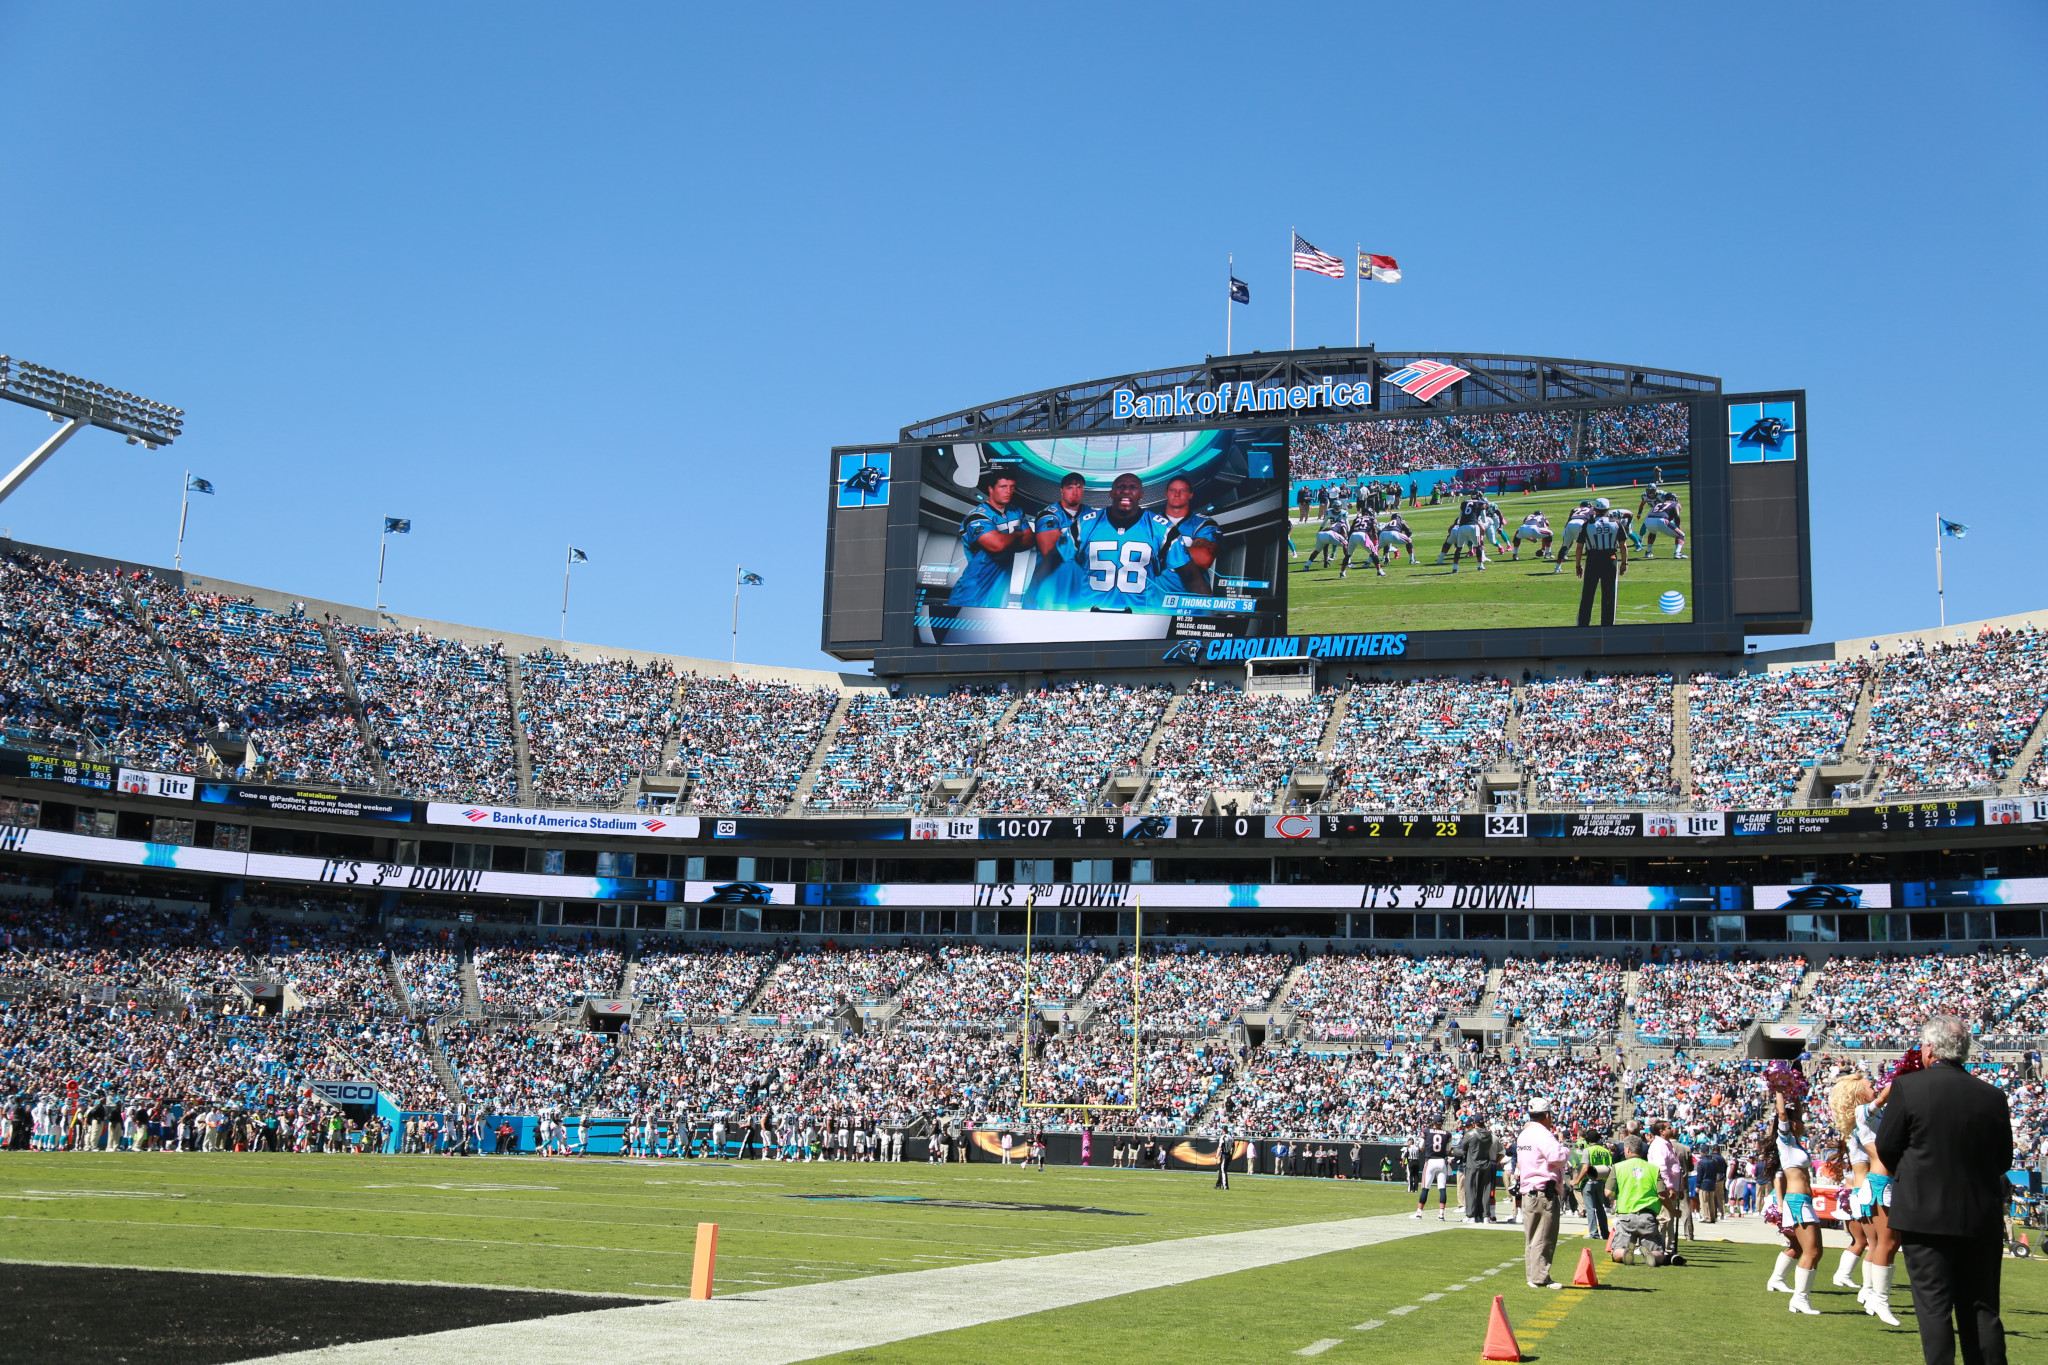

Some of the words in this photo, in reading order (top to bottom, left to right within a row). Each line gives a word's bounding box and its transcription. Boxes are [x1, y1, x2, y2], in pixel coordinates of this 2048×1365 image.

[1112, 385, 1194, 419] Bank
[1197, 382, 1231, 414] of
[1233, 376, 1372, 413] America
[1089, 541, 1152, 593] 58
[1166, 597, 1175, 607] LB
[1181, 598, 1212, 609] THOMAS
[1213, 600, 1236, 610] DAVIS
[1243, 601, 1253, 611] 58
[1206, 635, 1300, 661] CAROLINA
[1306, 633, 1408, 658] PANTHERS
[27, 755, 59, 765] CMP-ATT
[62, 759, 77, 768] YDS
[81, 762, 90, 770] TD
[92, 764, 111, 773] RATE
[64, 767, 78, 775] 105
[95, 772, 112, 780] 93.5
[63, 775, 77, 784] 100
[94, 780, 111, 788] 94.7
[158, 778, 188, 796] Lite
[239, 791, 258, 799] Come
[269, 795, 308, 805] @Panthers,
[337, 801, 362, 809] football
[362, 804, 393, 813] weekend!
[271, 803, 307, 812] #GOPACK
[307, 806, 360, 816] #GOPANTHERS
[1777, 809, 1811, 817] LEADING
[1812, 808, 1849, 816] RUSHERS
[2032, 801, 2048, 820] Li
[493, 811, 522, 825] Bank
[524, 813, 538, 826] of
[538, 814, 588, 829] America
[589, 817, 637, 830] Stadium
[1432, 815, 1448, 823] BALL
[1491, 816, 1519, 834] 34
[1736, 813, 1771, 824] IN-GAME
[1799, 816, 1829, 824] Reaves
[719, 823, 734, 834] CC
[946, 821, 974, 838] Lite
[997, 819, 1052, 837] 10:07
[1075, 825, 1081, 837] 1
[1108, 825, 1114, 833] 3
[1192, 819, 1204, 836] 7
[1235, 818, 1248, 836] 0
[1330, 823, 1337, 832] 3
[1370, 823, 1380, 837] 2
[1402, 823, 1413, 837] 7
[1436, 822, 1457, 836] 23
[1571, 825, 1636, 837] 704-438-4357
[1687, 817, 1718, 835] Lite
[1743, 823, 1766, 832] STATS
[1776, 825, 1792, 833] CHI
[1799, 825, 1821, 833] Forte
[1925, 819, 1938, 827] 2.7
[320, 859, 361, 884] IT'S
[372, 864, 403, 886] 3RD
[408, 866, 483, 892] DOWN!
[976, 884, 1015, 907] IT'S
[1027, 885, 1053, 907] 3RD
[1060, 885, 1130, 907] DOWN!
[1360, 885, 1402, 909] IT'S
[1415, 885, 1445, 909] 3RD
[1452, 885, 1530, 909] DOWN!
[267, 1095, 274, 1105] 2
[1433, 1134, 1442, 1153] 8
[1812, 1196, 1826, 1211] G
